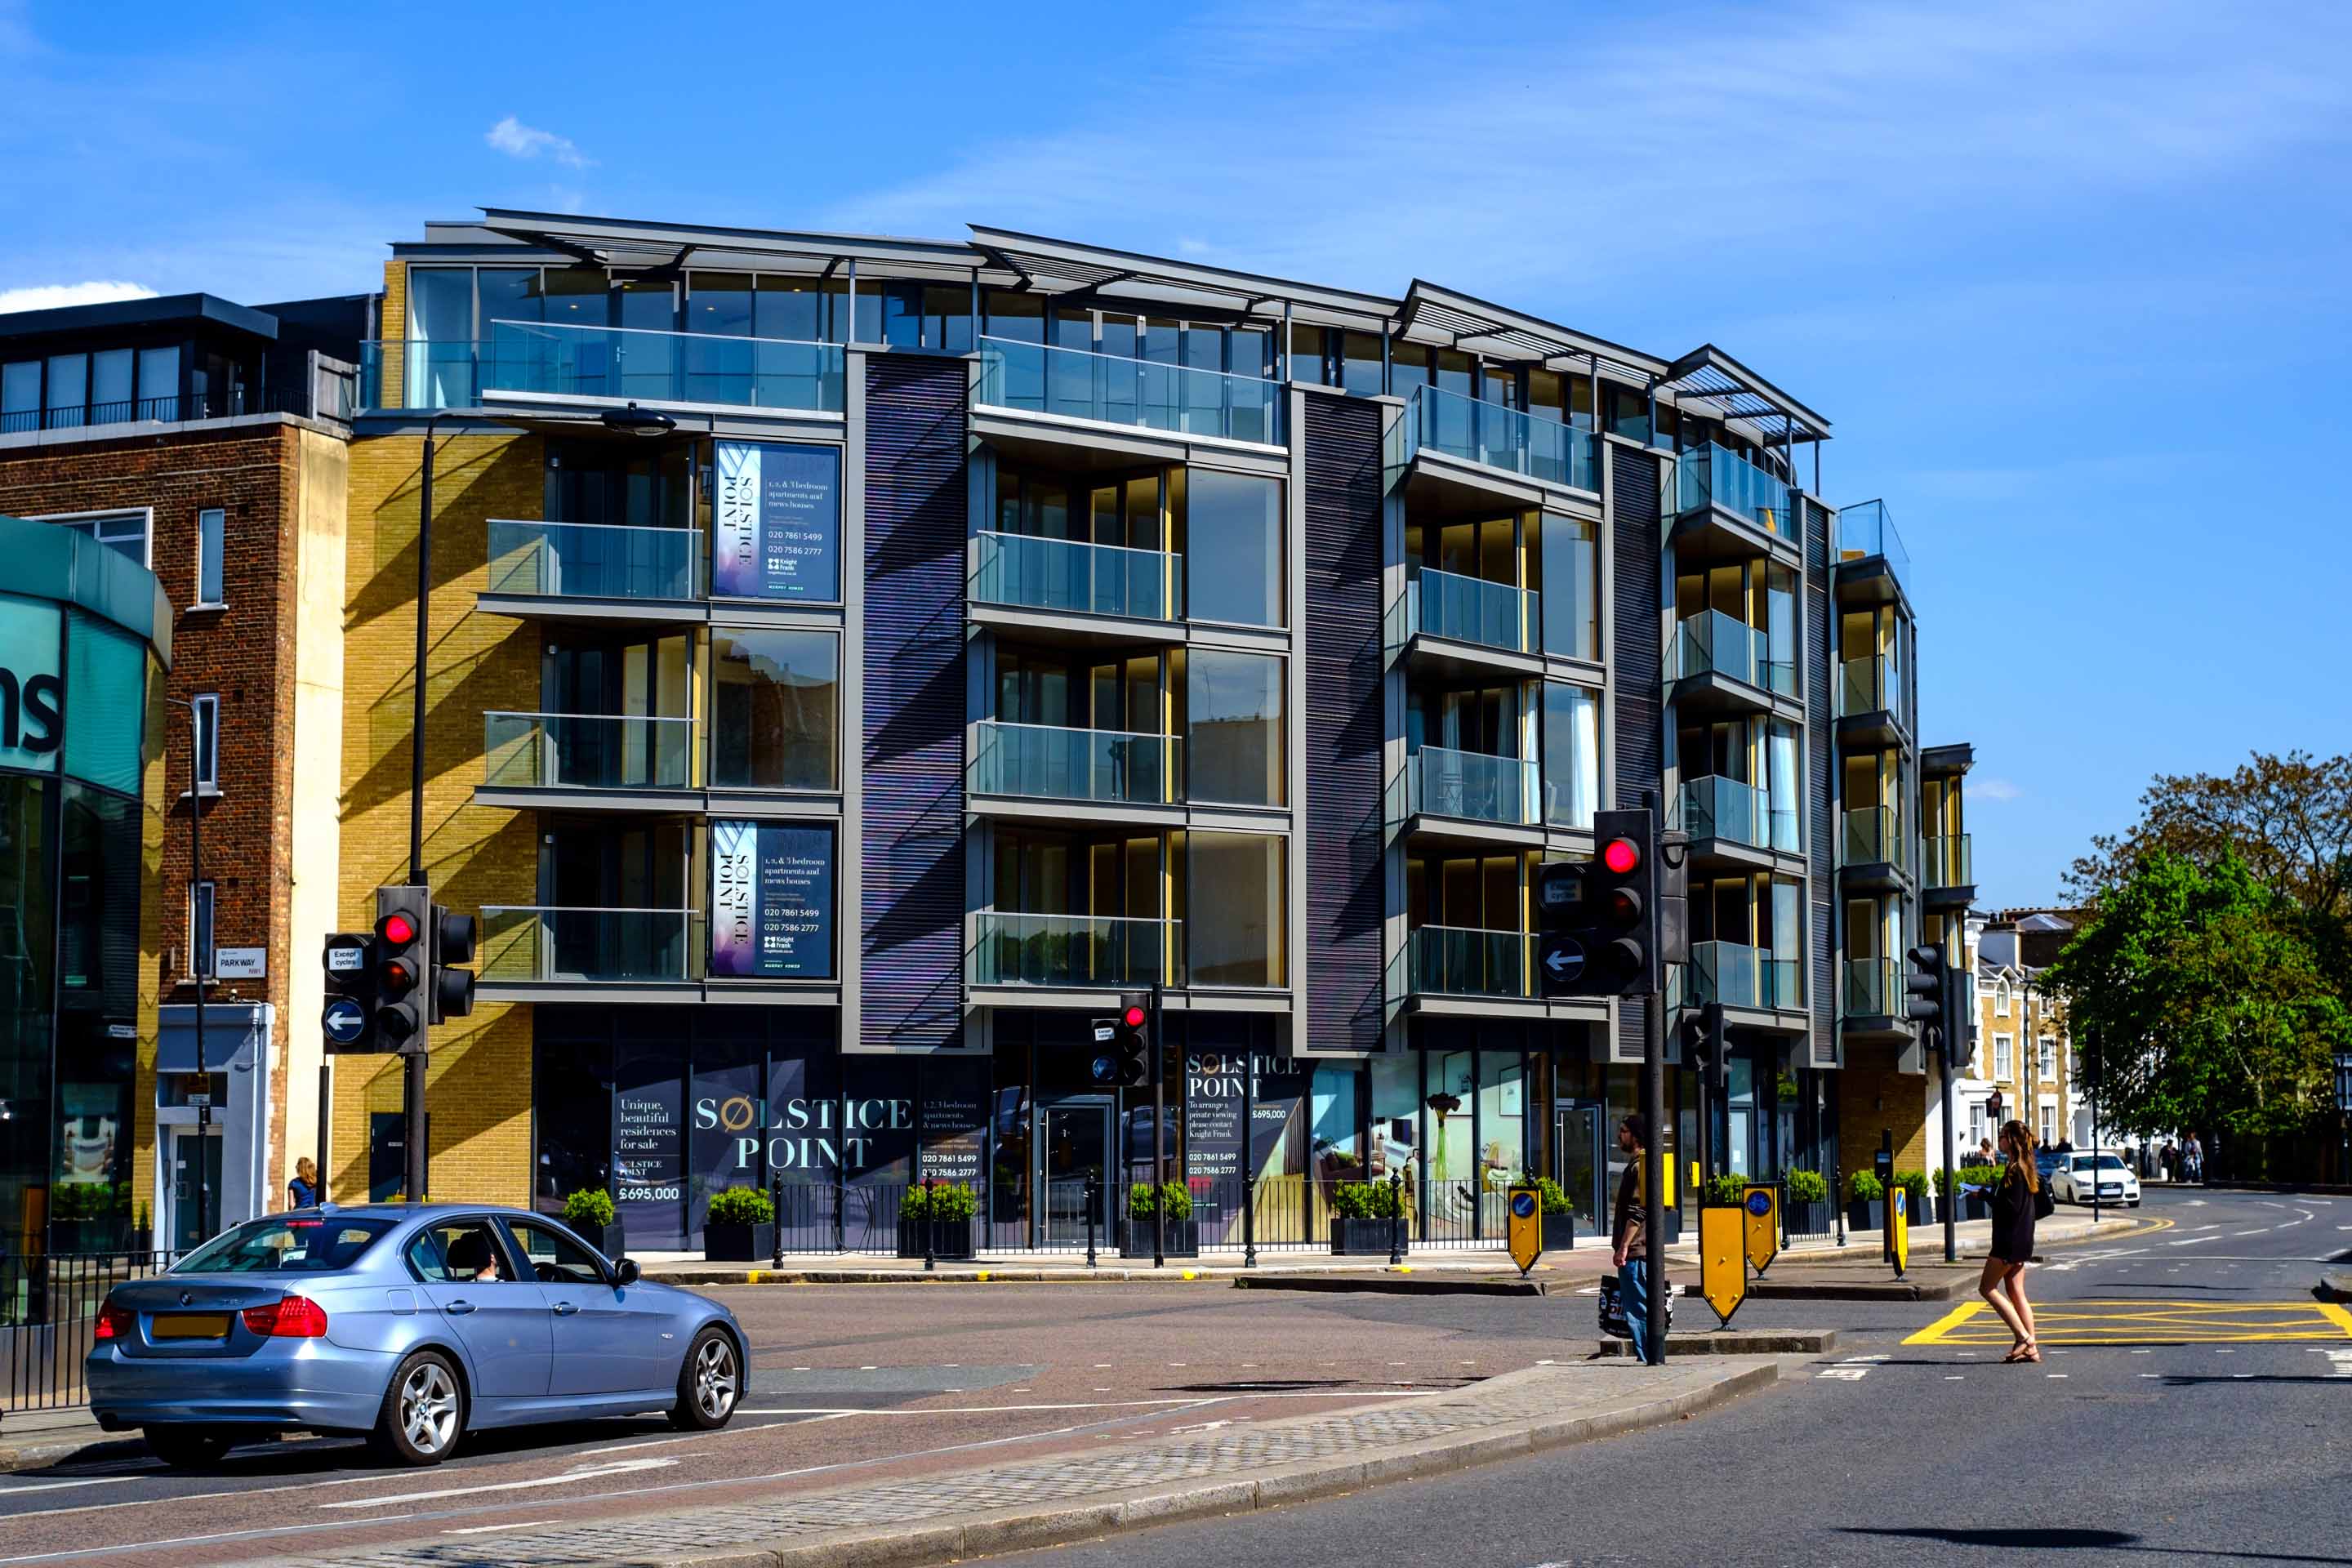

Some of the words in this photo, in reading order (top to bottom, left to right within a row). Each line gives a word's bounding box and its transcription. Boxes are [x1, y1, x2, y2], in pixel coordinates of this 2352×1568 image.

[782, 480, 788, 488] &
[795, 481, 829, 491] bedroom
[768, 491, 808, 500] apartments
[724, 476, 737, 531] POINT
[768, 531, 784, 539] 020
[785, 532, 801, 540] 7861
[803, 532, 822, 541] 5499
[768, 546, 783, 554] 020
[784, 546, 803, 555] 7586
[804, 547, 822, 555] 2777
[792, 858, 825, 866] bedroom
[719, 855, 733, 910] POINT
[786, 876, 811, 885] houses
[764, 908, 780, 916] 020
[781, 924, 800, 932] 7586
[220, 959, 255, 967] PARKWAY
[1188, 1077, 1262, 1098] POINT
[621, 1098, 663, 1112] Unique,
[943, 1099, 977, 1110] bedroom
[621, 1112, 669, 1123] beautiful
[1189, 1111, 1211, 1120] private
[1212, 1111, 1237, 1120] viewing
[1252, 1110, 1285, 1119] £695,000
[1189, 1121, 1209, 1129] please
[621, 1125, 677, 1137] residences
[1189, 1130, 1211, 1139] Knight
[621, 1138, 636, 1149] for
[638, 1139, 658, 1149] sale
[735, 1138, 873, 1169] POINT
[619, 1187, 679, 1200] £695,000
